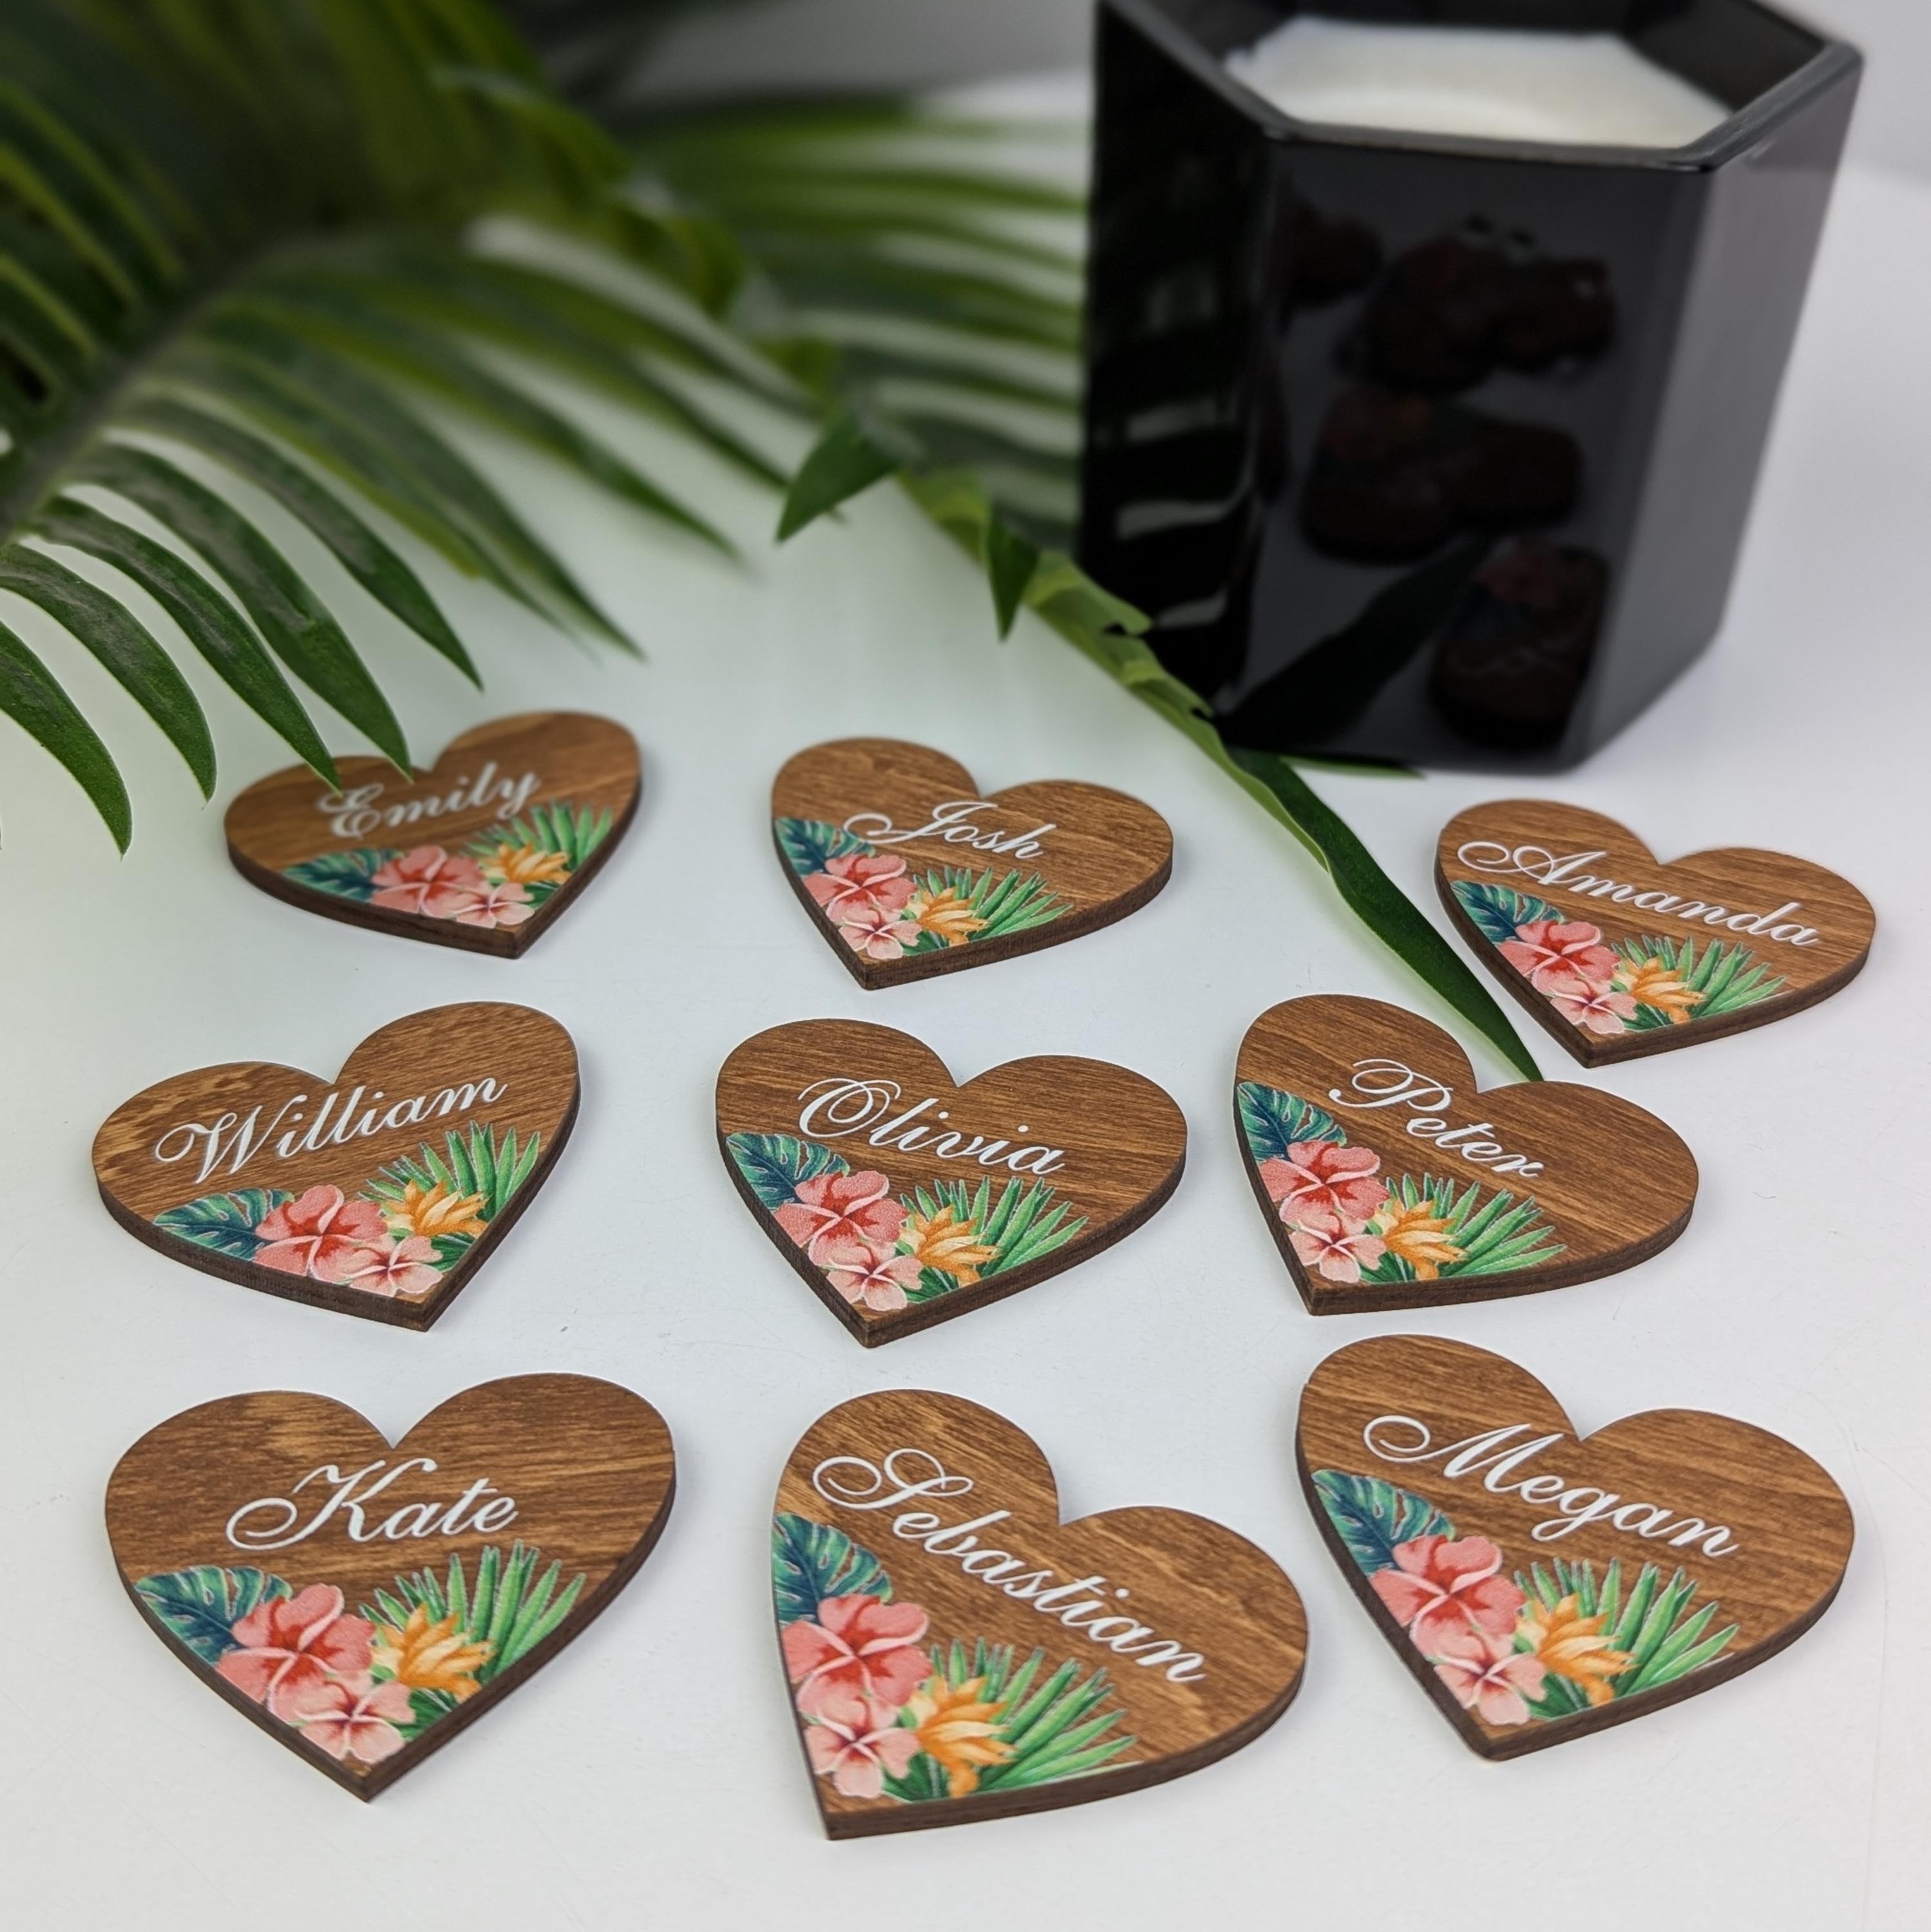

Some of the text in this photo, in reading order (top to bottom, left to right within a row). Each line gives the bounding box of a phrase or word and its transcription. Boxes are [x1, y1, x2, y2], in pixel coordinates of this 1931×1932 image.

[316, 762, 540, 840] Emily
[843, 800, 1056, 860] Josh
[1456, 840, 1819, 947] Amanda
[153, 1077, 508, 1185] William
[796, 1077, 1066, 1176] Olivia
[1327, 1057, 1545, 1179] Peter
[224, 1457, 519, 1551] Kate
[1362, 1414, 1739, 1558] Megan
[811, 1447, 1206, 1685] Sebastian
